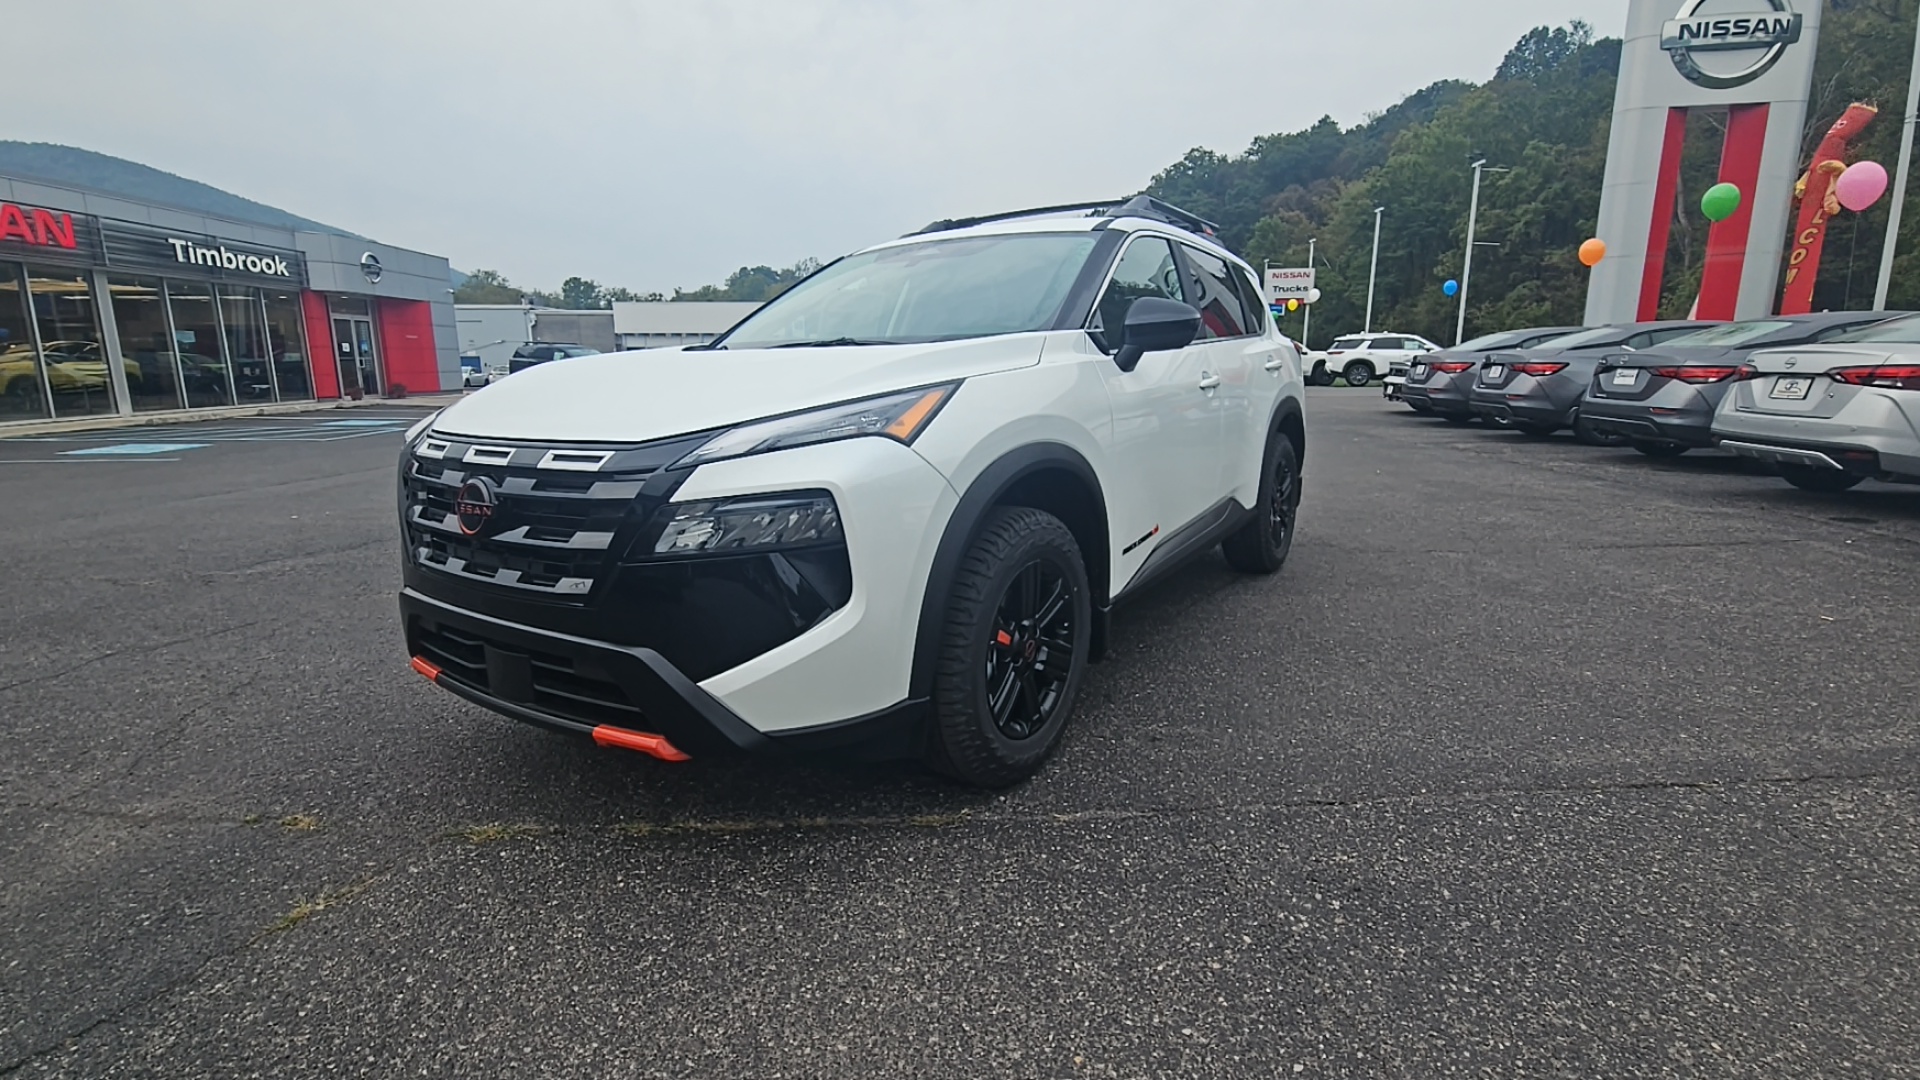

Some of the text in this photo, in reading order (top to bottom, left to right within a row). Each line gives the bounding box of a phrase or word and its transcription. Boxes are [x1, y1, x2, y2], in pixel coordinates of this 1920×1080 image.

[1678, 18, 1791, 40] NISSAN
[167, 237, 290, 277] Timbrook
[1272, 271, 1311, 279] NISSAN
[1272, 285, 1309, 293] Trucks
